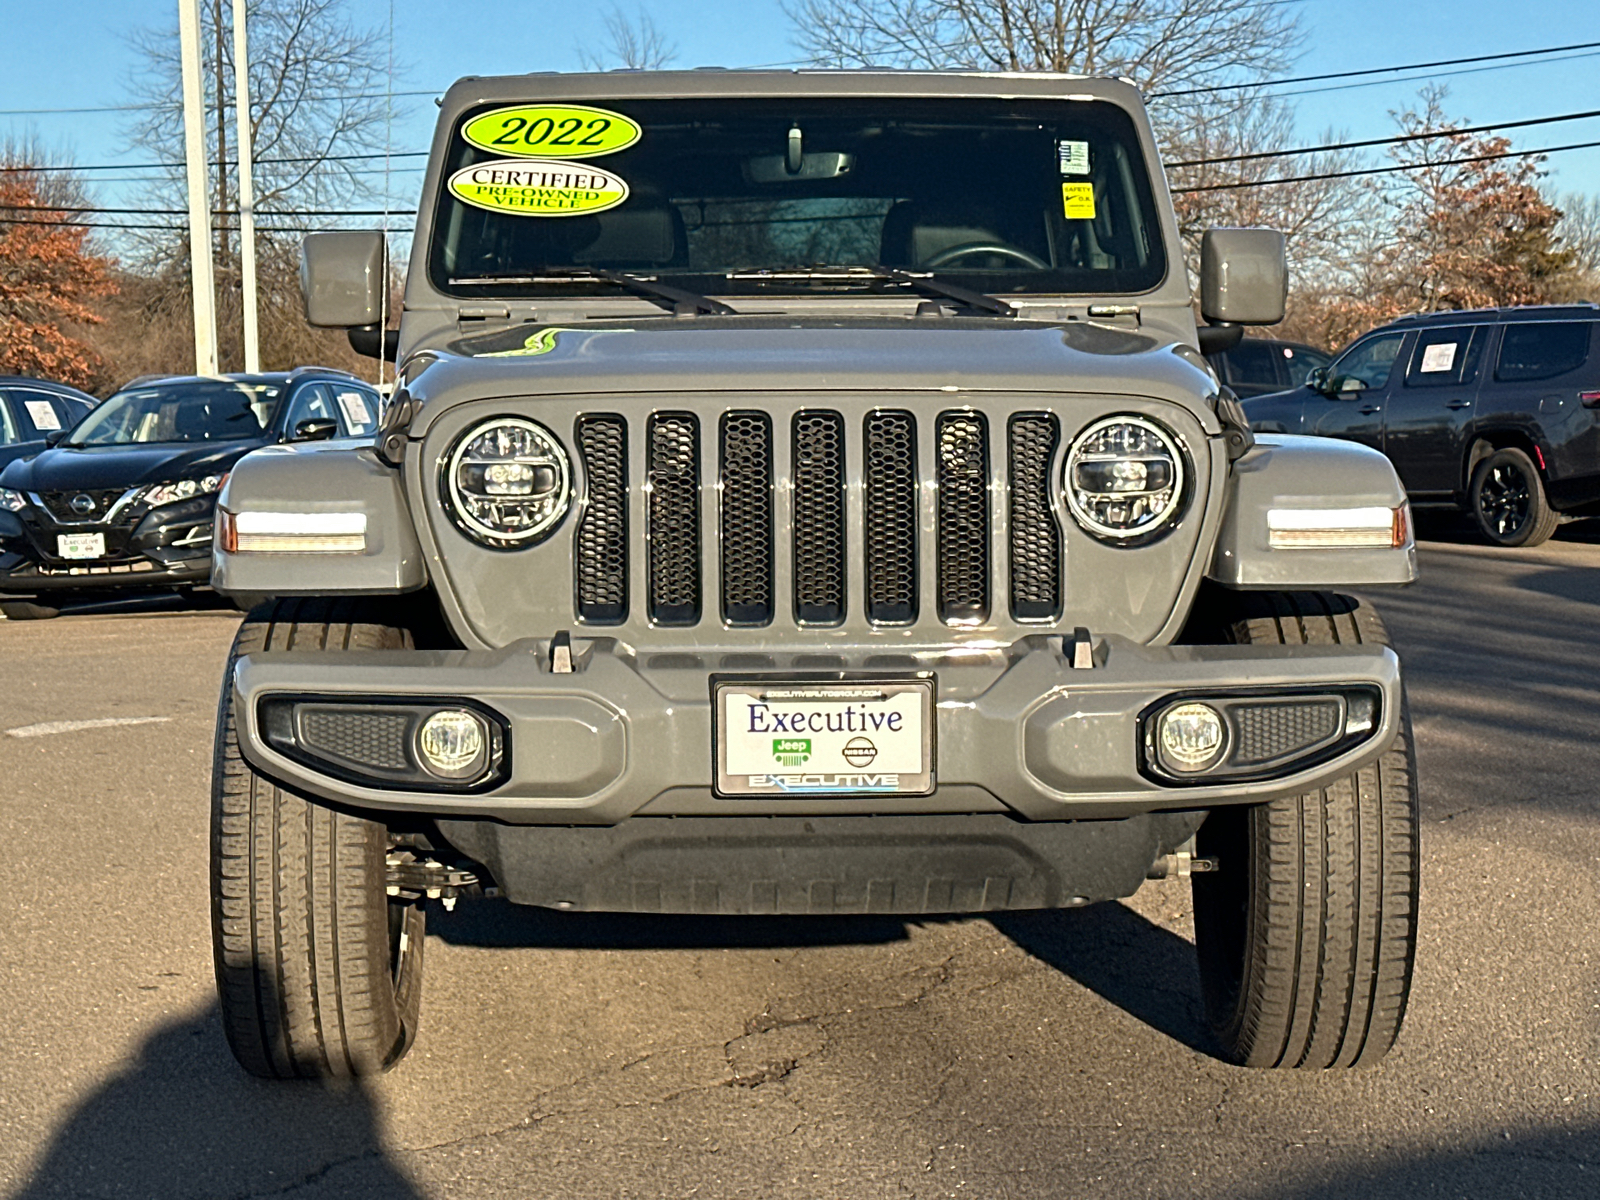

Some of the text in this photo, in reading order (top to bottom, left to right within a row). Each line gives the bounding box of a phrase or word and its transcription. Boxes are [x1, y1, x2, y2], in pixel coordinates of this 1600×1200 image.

[491, 117, 611, 146] 2022
[471, 169, 608, 190] CERTIFIED
[475, 186, 600, 201] PRE-OWNED
[493, 195, 581, 209] VEHICLE
[746, 703, 903, 733] Executive
[777, 739, 807, 752] Jeep
[748, 774, 900, 787] EXECUTIVE
